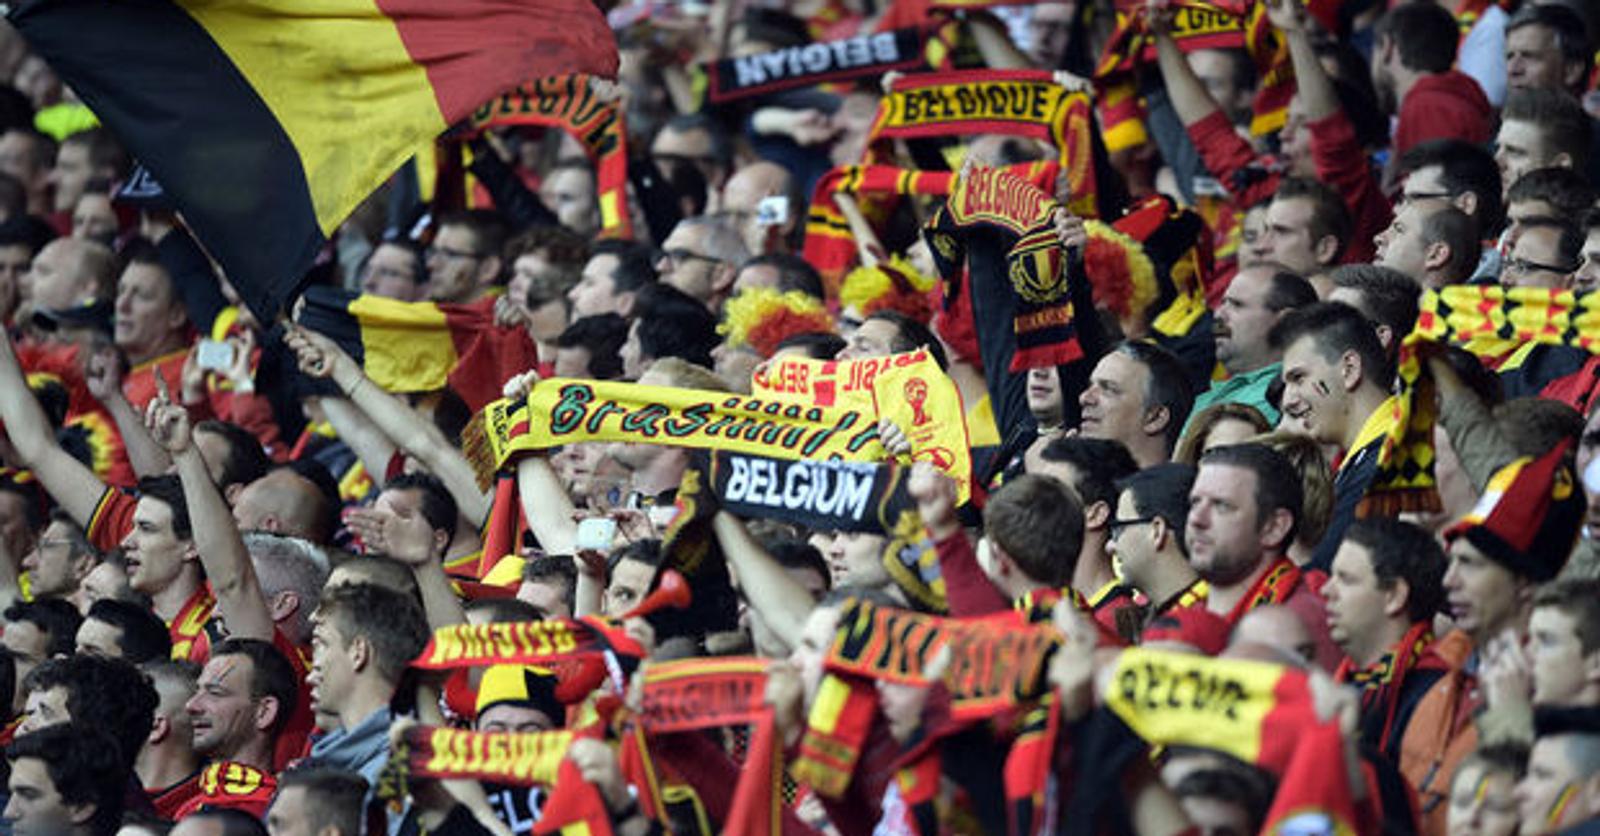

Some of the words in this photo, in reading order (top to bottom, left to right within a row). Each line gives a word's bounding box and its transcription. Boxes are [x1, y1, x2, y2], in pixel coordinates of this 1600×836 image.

[735, 32, 899, 86] BELGIAN
[903, 84, 1049, 121] BELGIQUE
[725, 456, 877, 521] BELGIUM
